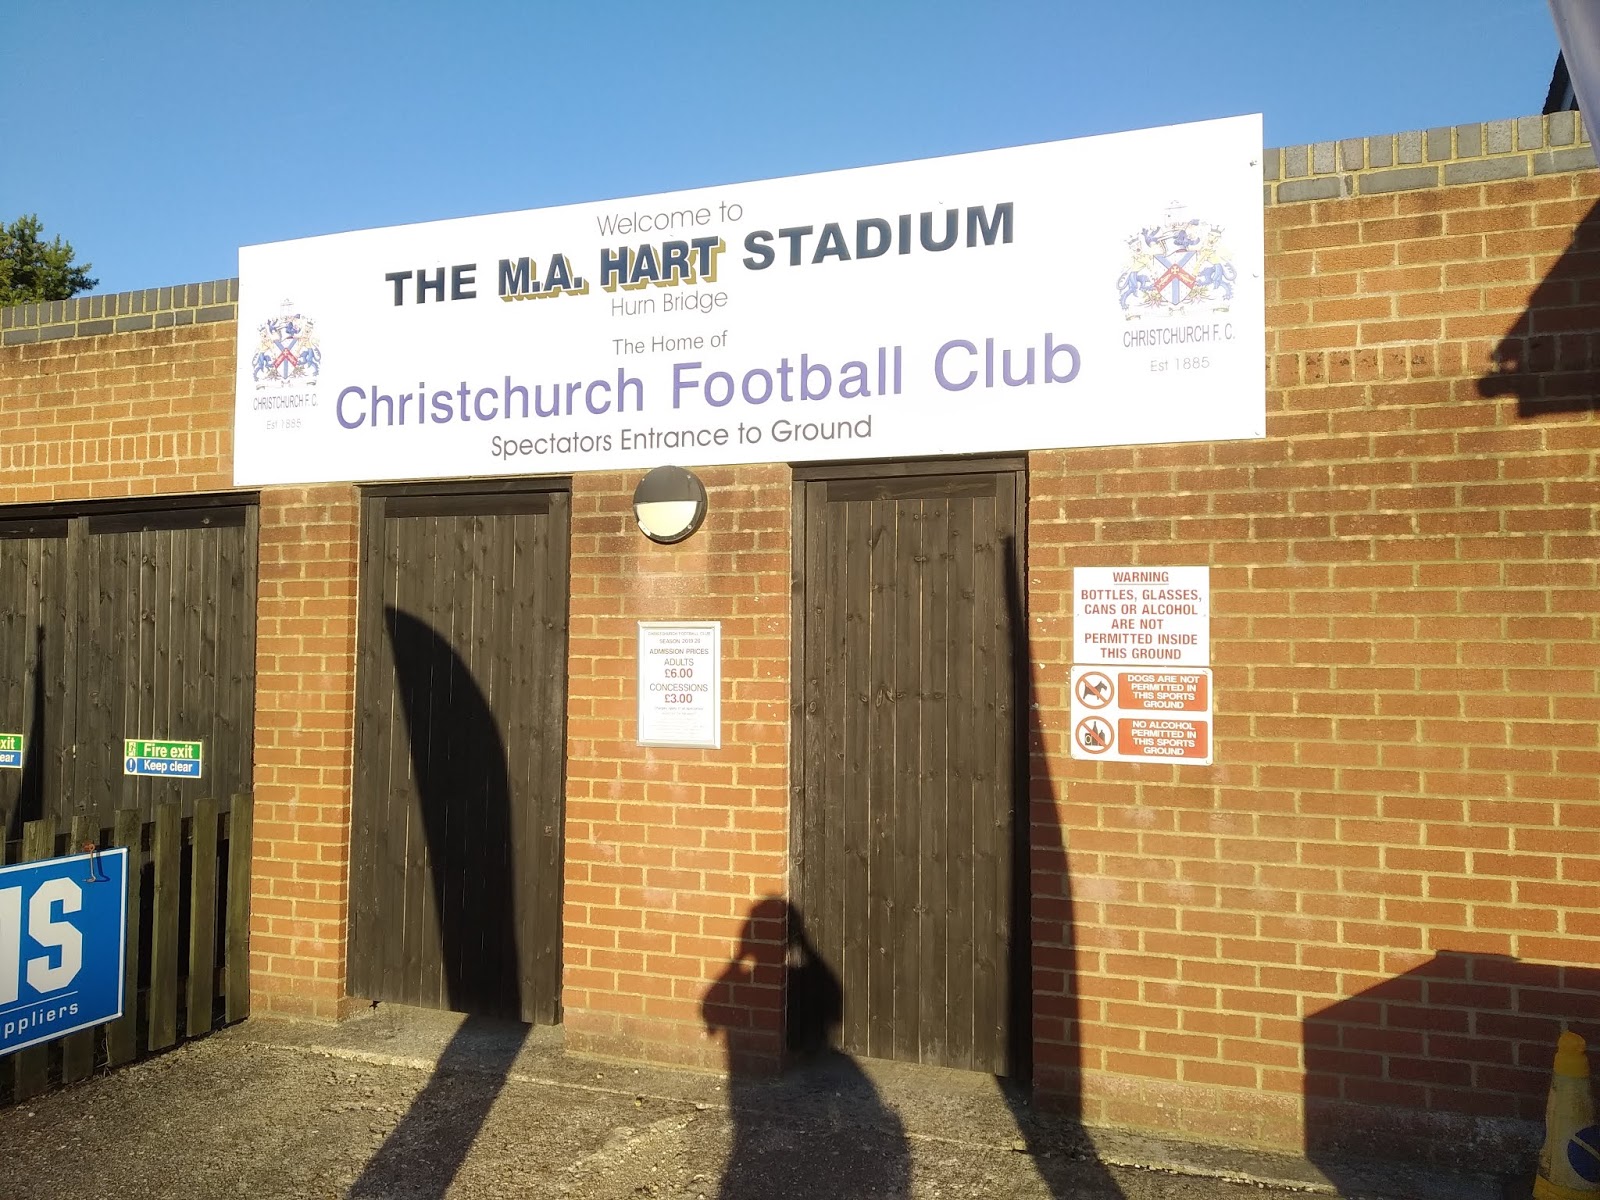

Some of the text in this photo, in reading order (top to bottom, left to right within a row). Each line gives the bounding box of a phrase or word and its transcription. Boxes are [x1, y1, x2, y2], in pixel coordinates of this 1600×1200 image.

[597, 201, 742, 236] Welcome to
[385, 202, 1014, 306] THE M.A. HART STADIUM
[612, 291, 728, 316] Hurn Bridge
[1123, 325, 1209, 347] CHRISTCHURCH
[612, 330, 728, 355] The Home of
[1151, 357, 1210, 371] Est 1885
[336, 333, 1080, 429] Christchurch Football Club
[253, 394, 304, 411] CHRISTCHURCH
[282, 418, 301, 428] 1885
[492, 415, 871, 460] Spectators Entrance to Ground
[1113, 572, 1168, 582] WARNING
[1081, 590, 1201, 602] BOTTLES, GLASSES,
[1085, 604, 1198, 615] CANS OR ALCOHOL
[1112, 619, 1163, 629] ARE NOT
[1085, 633, 1197, 644] PERMITTED INSIDE
[1100, 648, 1181, 659] THIS GROUND
[664, 658, 694, 666] ADULTS
[665, 668, 692, 678] £6.00
[1128, 674, 1155, 682] DOGS
[1180, 676, 1200, 684] NOT
[650, 683, 708, 692] CONCESSIONS
[1131, 684, 1196, 692] PERMITTED IN
[664, 694, 692, 703] £3.00
[1133, 692, 1195, 700] THIS SPORTS
[1144, 700, 1184, 709] GROUND
[1132, 720, 1196, 730] NO ALCOHOL
[1131, 729, 1196, 738] PERMITTED IN
[0, 737, 15, 749] xit
[1133, 738, 1196, 747] THIS SPORTS
[144, 744, 192, 758] Fire exit
[144, 759, 192, 773] Keep clear
[0, 1002, 79, 1039] ppliers
